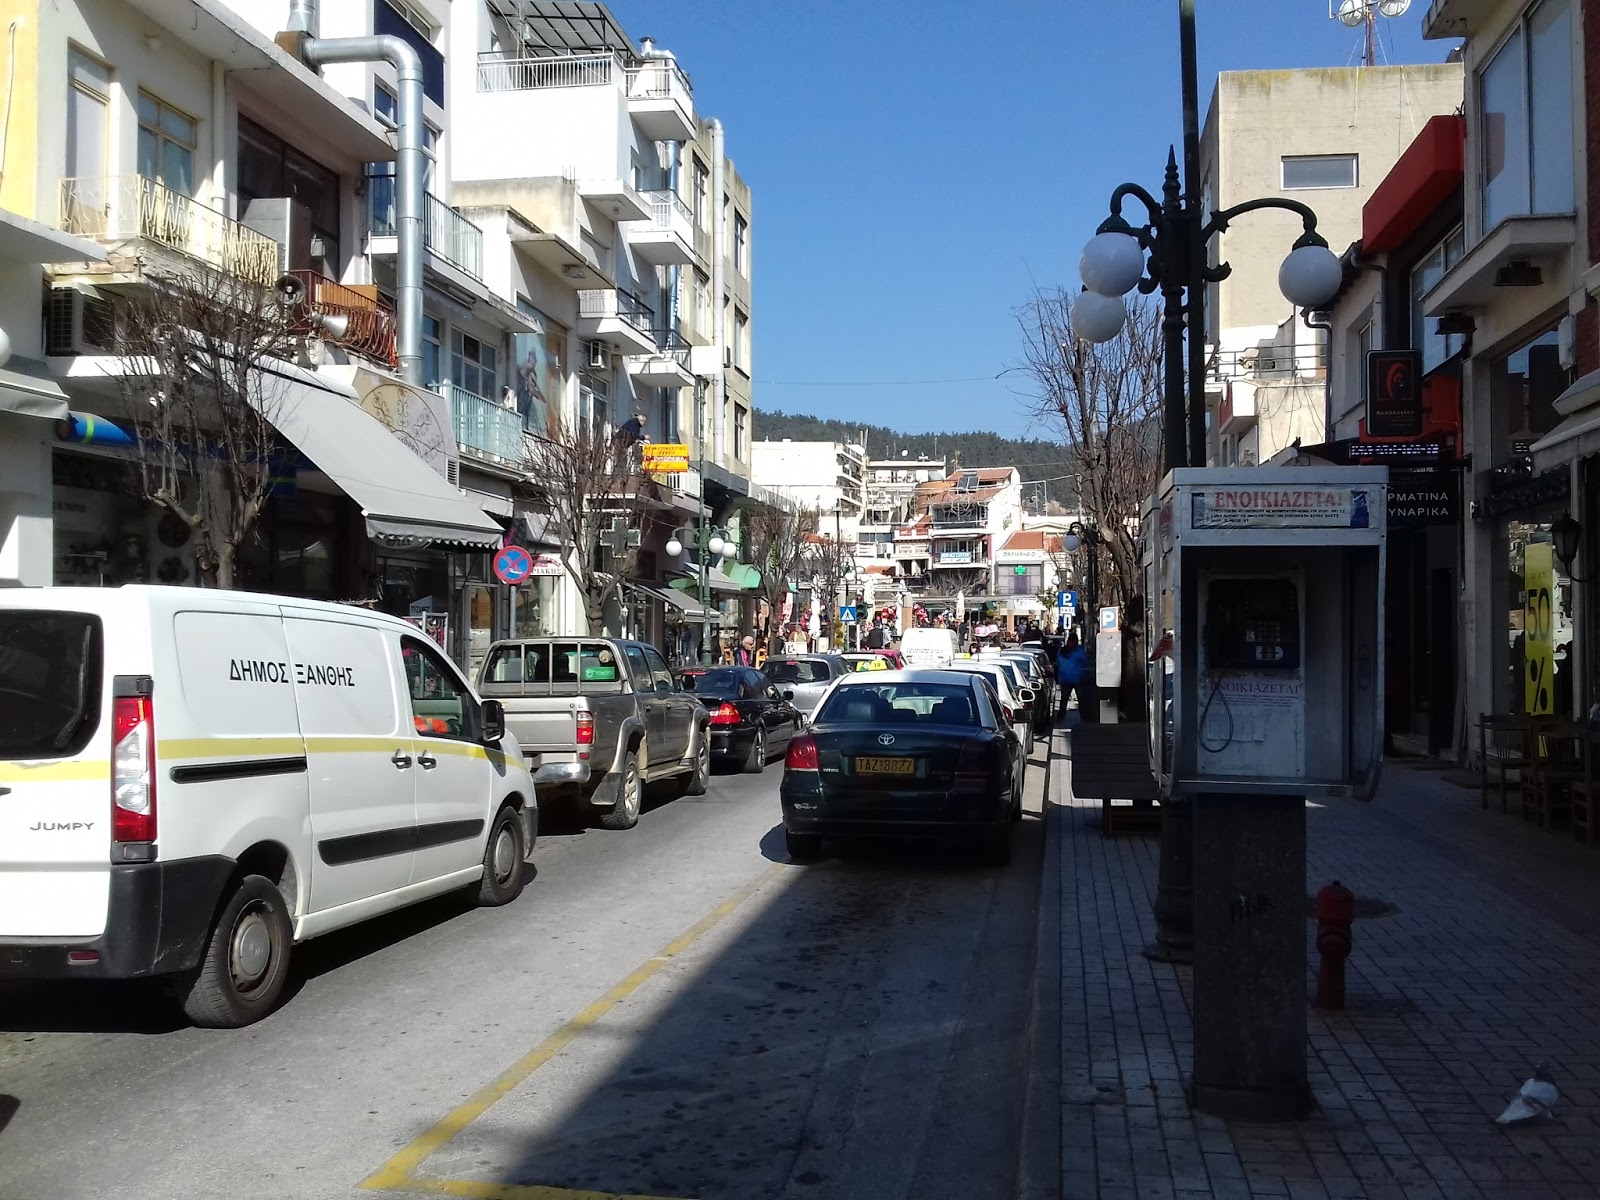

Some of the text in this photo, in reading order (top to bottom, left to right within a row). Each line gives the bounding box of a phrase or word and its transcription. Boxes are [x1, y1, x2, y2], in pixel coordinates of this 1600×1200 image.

[1387, 492, 1449, 501] ΡΜΑΤΙΝΑ
[1388, 507, 1449, 516] ΥΝΑΡΙΚΑ
[1102, 610, 1115, 626] P
[1527, 587, 1550, 641] 50
[229, 659, 355, 686] ΔΗΜΟΣ ΞΑΝΘΗΣ
[858, 758, 913, 772] TAZ 8827
[29, 821, 95, 831] JUMPY
